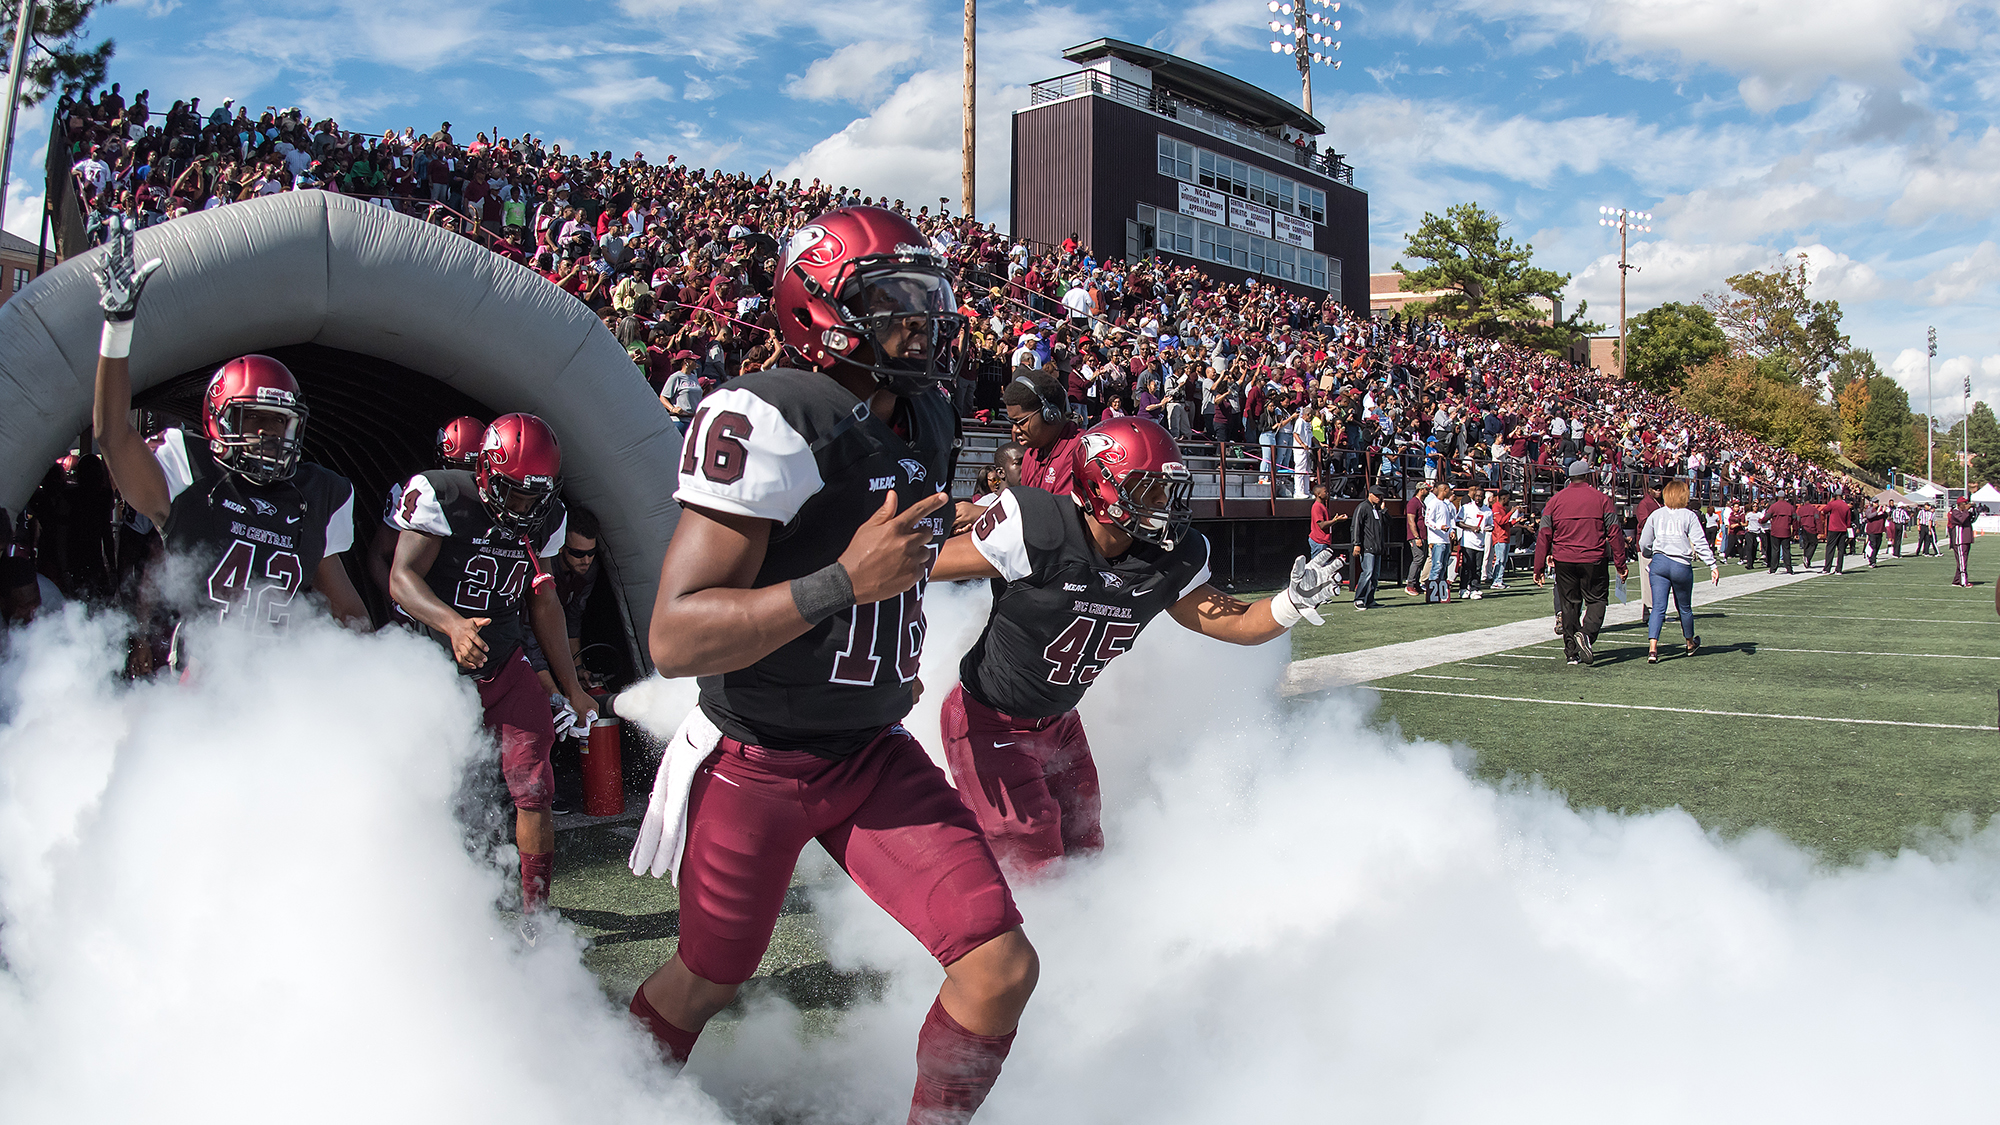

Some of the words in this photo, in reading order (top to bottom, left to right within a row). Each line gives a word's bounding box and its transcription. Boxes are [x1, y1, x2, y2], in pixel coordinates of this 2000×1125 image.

[1195, 188, 1210, 198] NCAA
[1181, 193, 1199, 203] DIVISION
[1205, 200, 1223, 210] PLAYOFFS
[1230, 199, 1244, 208] CENTRAL
[1245, 203, 1270, 216] INTERCOLLEGIATE
[1189, 203, 1217, 217] APPEARANCES
[1230, 207, 1247, 217] ATHLETIC
[1250, 213, 1270, 224] ASSOCIATION
[1245, 219, 1256, 228] CIAA
[1277, 221, 1290, 230] ATHLETIC
[1292, 226, 1312, 237] CONFERENCE
[1284, 216, 1305, 227] MID-EASTERN
[1288, 232, 1302, 241] MEAC
[681, 406, 753, 485] 16
[869, 476, 896, 492] MEAC
[222, 499, 246, 513] MEAC
[1476, 514, 1484, 528] 7
[230, 521, 246, 536] NC
[246, 526, 293, 548] CENTRAL
[492, 548, 525, 558] CENTRAL
[208, 539, 302, 638] 42
[454, 554, 529, 610] 24
[1063, 583, 1087, 592] MEAC
[1429, 581, 1449, 602] 20
[829, 543, 939, 686] 16
[1073, 600, 1089, 612] NC
[1089, 603, 1132, 618] CENTRAL
[1044, 616, 1140, 686] 45
